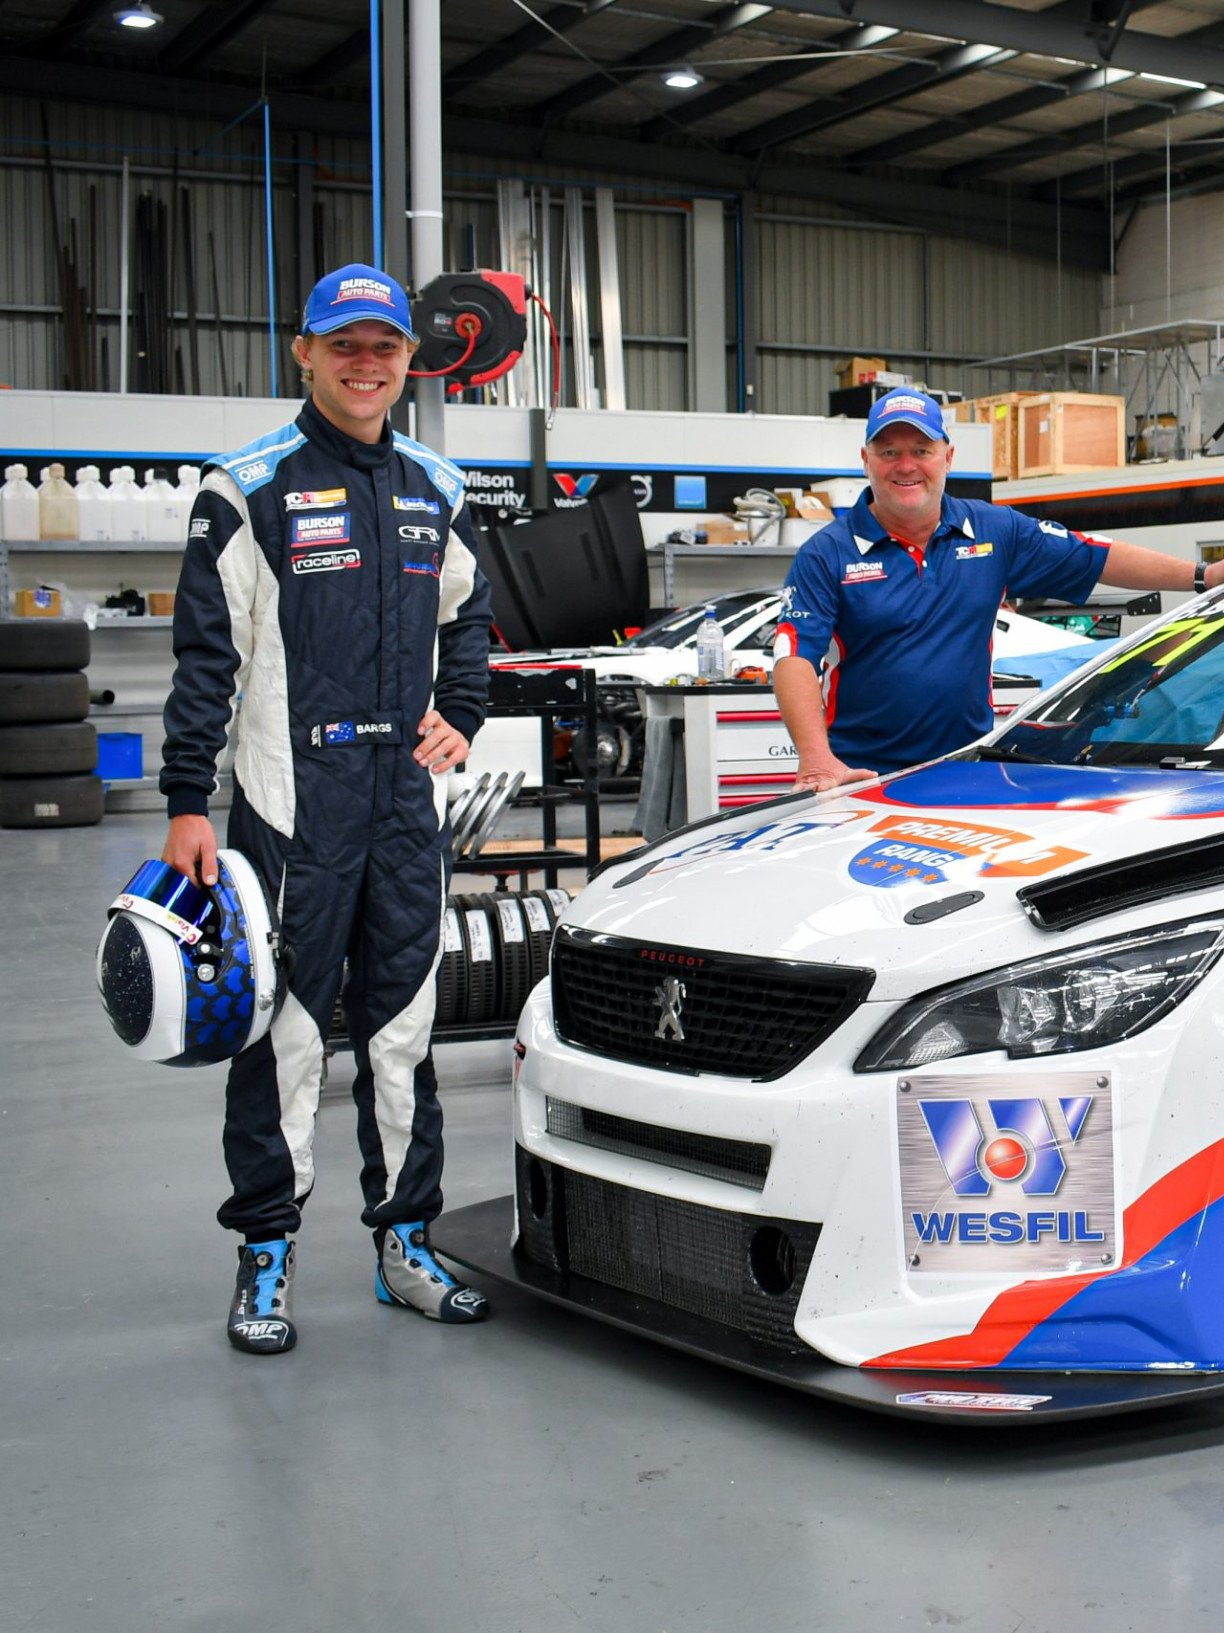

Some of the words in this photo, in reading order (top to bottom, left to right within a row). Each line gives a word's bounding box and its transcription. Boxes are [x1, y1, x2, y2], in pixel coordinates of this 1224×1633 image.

[339, 278, 391, 294] BURSON
[341, 288, 364, 298] AUTO
[363, 289, 389, 300] PARTS
[238, 463, 269, 482] OMP
[435, 471, 456, 491] OMP
[464, 489, 526, 509] ecurity
[297, 516, 345, 530] BURSON
[300, 529, 320, 538] AUTO
[320, 527, 342, 535] PARTS
[296, 554, 357, 569] raceline
[846, 562, 883, 574] BURSON
[356, 723, 392, 735] BARGS
[873, 844, 962, 867] RANG
[641, 949, 705, 967] PEUGEOT
[911, 1211, 1106, 1244] WESFIL
